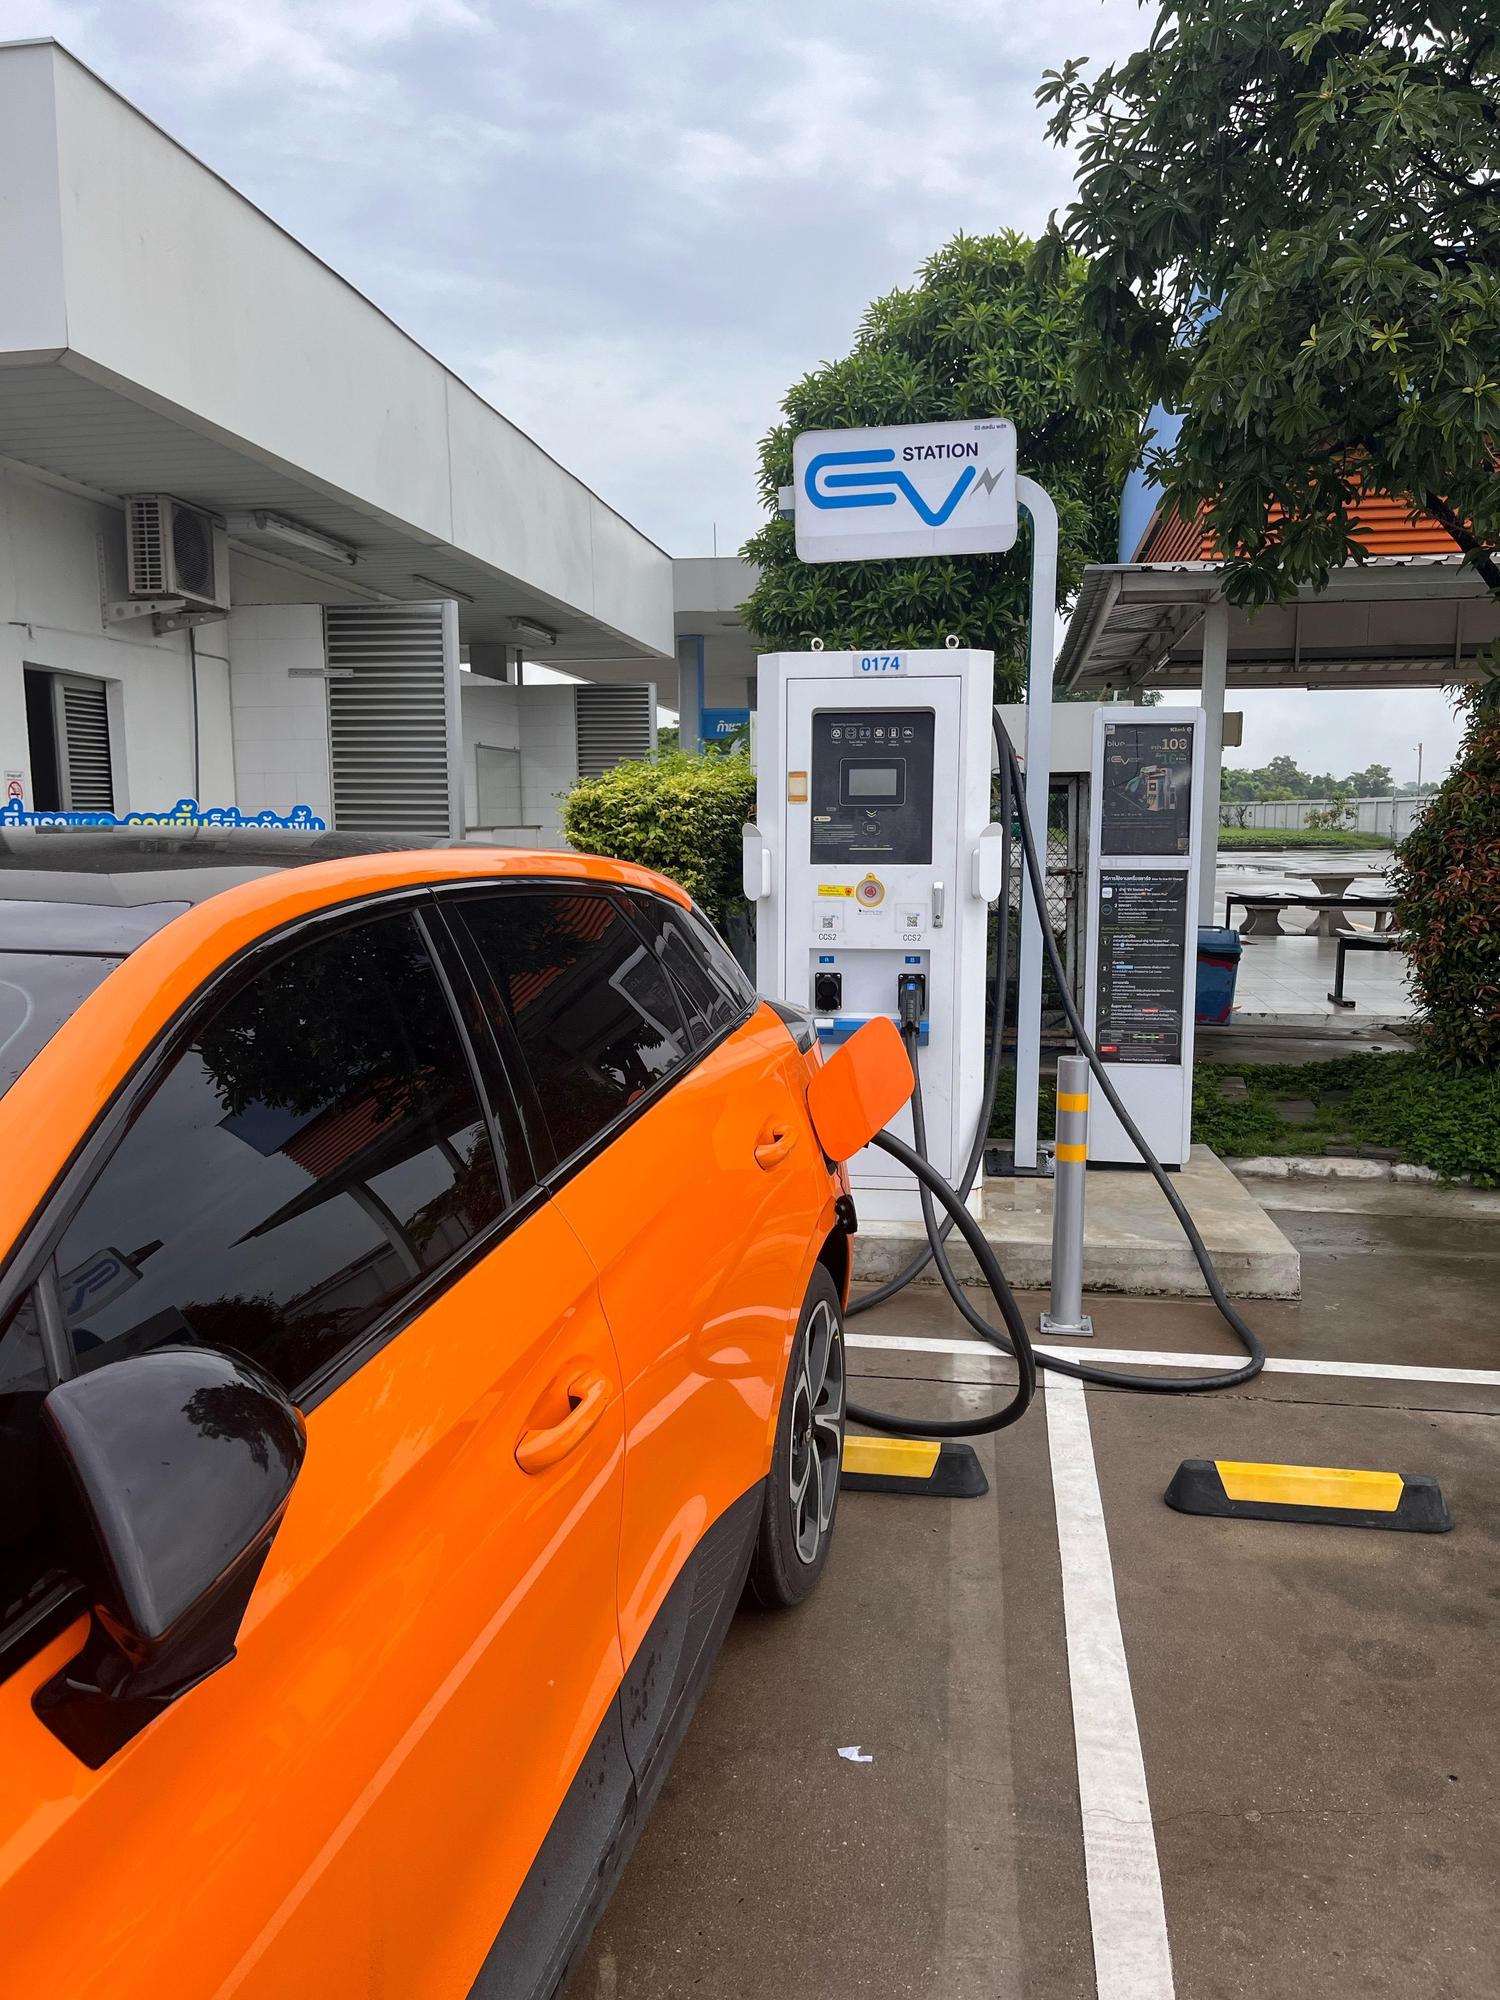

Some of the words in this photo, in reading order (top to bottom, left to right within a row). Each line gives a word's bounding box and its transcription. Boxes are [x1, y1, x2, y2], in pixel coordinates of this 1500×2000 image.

[902, 442, 979, 461] STATION
[804, 448, 977, 527] EV
[861, 656, 900, 672] 0174
[818, 933, 837, 941] CCS2
[902, 934, 922, 942] CCS2
